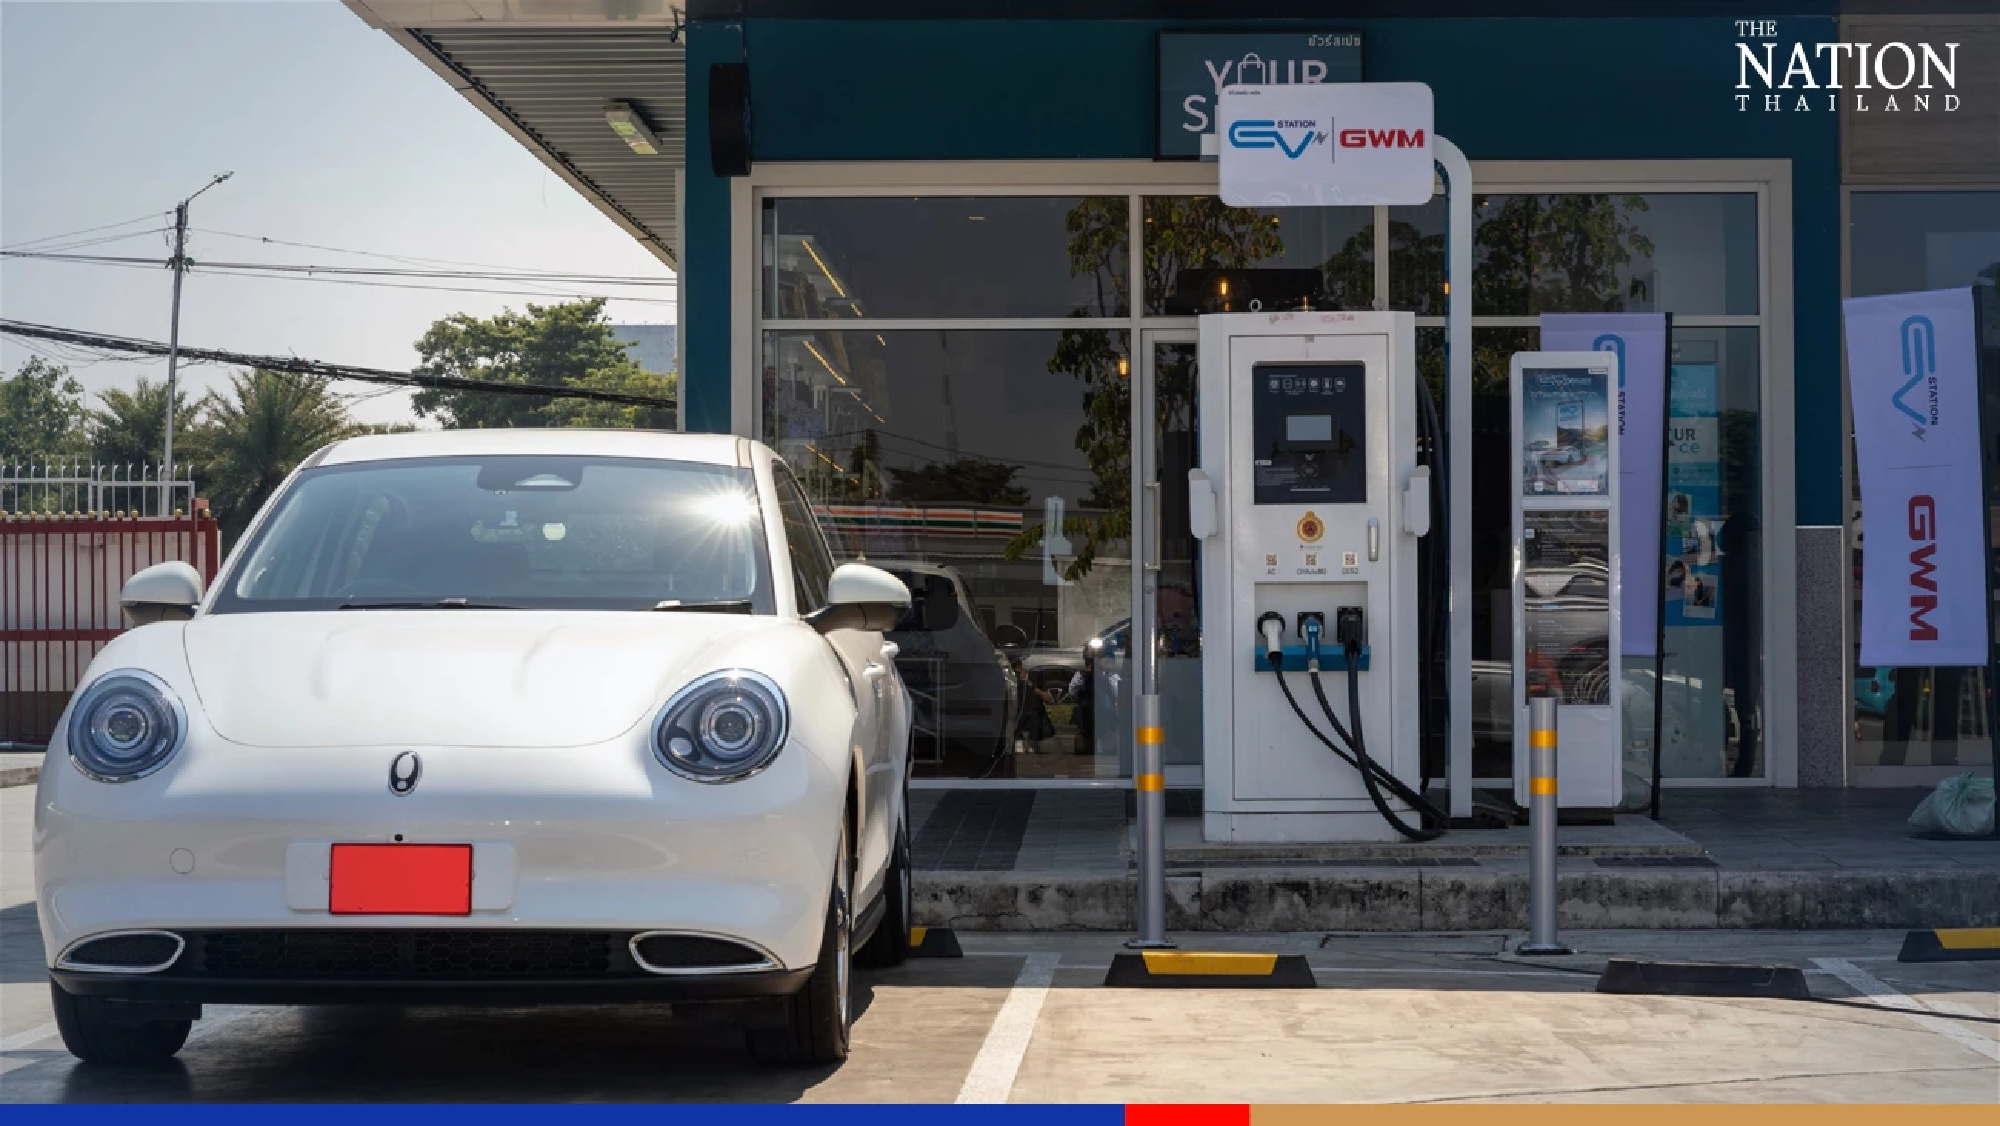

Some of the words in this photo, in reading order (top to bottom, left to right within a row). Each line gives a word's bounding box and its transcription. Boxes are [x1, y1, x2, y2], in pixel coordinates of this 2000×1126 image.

[1277, 120, 1316, 128] STATION
[1340, 128, 1426, 148] GWM
[1229, 120, 1315, 159] EV
[1928, 376, 1938, 426] STATION
[1670, 428, 1696, 441] UR
[1908, 494, 1938, 641] GWM
